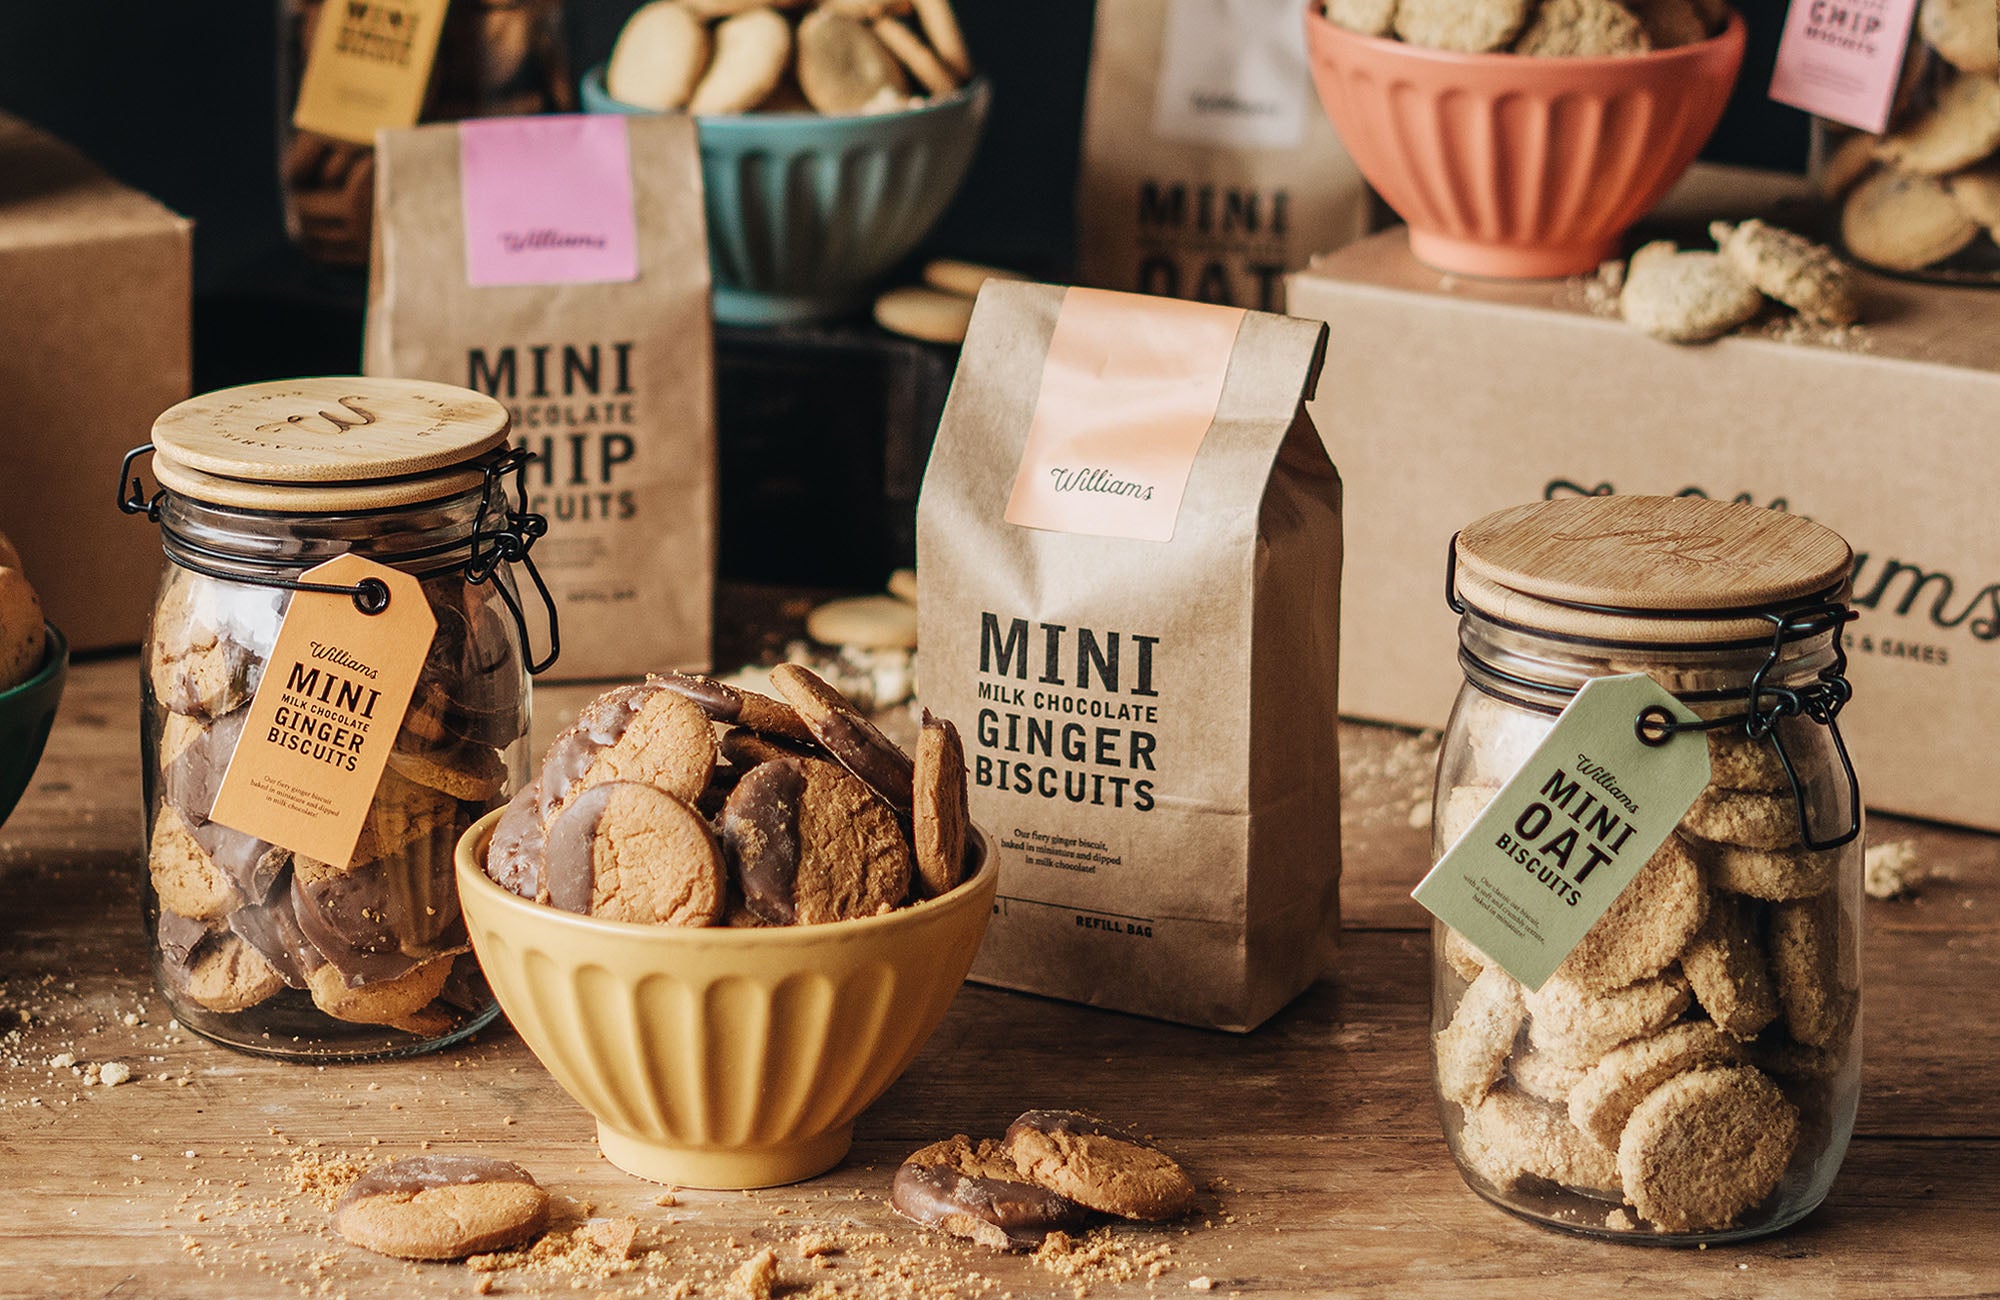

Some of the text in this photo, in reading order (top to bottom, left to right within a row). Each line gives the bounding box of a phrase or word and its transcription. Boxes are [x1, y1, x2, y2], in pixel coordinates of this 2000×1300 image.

[1809, 1, 1881, 35] CHIP
[1140, 180, 1288, 234] MINI
[468, 342, 636, 398] MINI
[511, 402, 634, 428] OCOLATE
[516, 433, 635, 485] HIP
[529, 491, 636, 521] CUITS
[1051, 467, 1154, 501] Williams
[310, 641, 378, 679] Williams
[979, 611, 1160, 697] MINI
[1881, 638, 1949, 664] CAKES
[281, 693, 370, 733] MILK CHOCOLATE
[286, 661, 381, 720] MINI
[978, 681, 1158, 723] MILK CHOCOLATE
[267, 726, 358, 772] BISCUITS
[275, 706, 365, 754] GINGER
[977, 708, 1156, 771] GINGER
[976, 755, 1155, 812] BISCUITS
[1577, 753, 1640, 815] Williams
[1539, 768, 1638, 856] MINI
[1001, 838, 1122, 866] baked in miniature and dipped
[1014, 828, 1030, 839] Our
[1032, 830, 1050, 844] fiery
[1052, 835, 1077, 848] ginger
[1514, 801, 1613, 885] OAT
[1025, 855, 1034, 864] in
[1035, 857, 1053, 868] milk
[1495, 832, 1582, 907] BISCUITS
[1075, 915, 1153, 938] REFILL BAG
